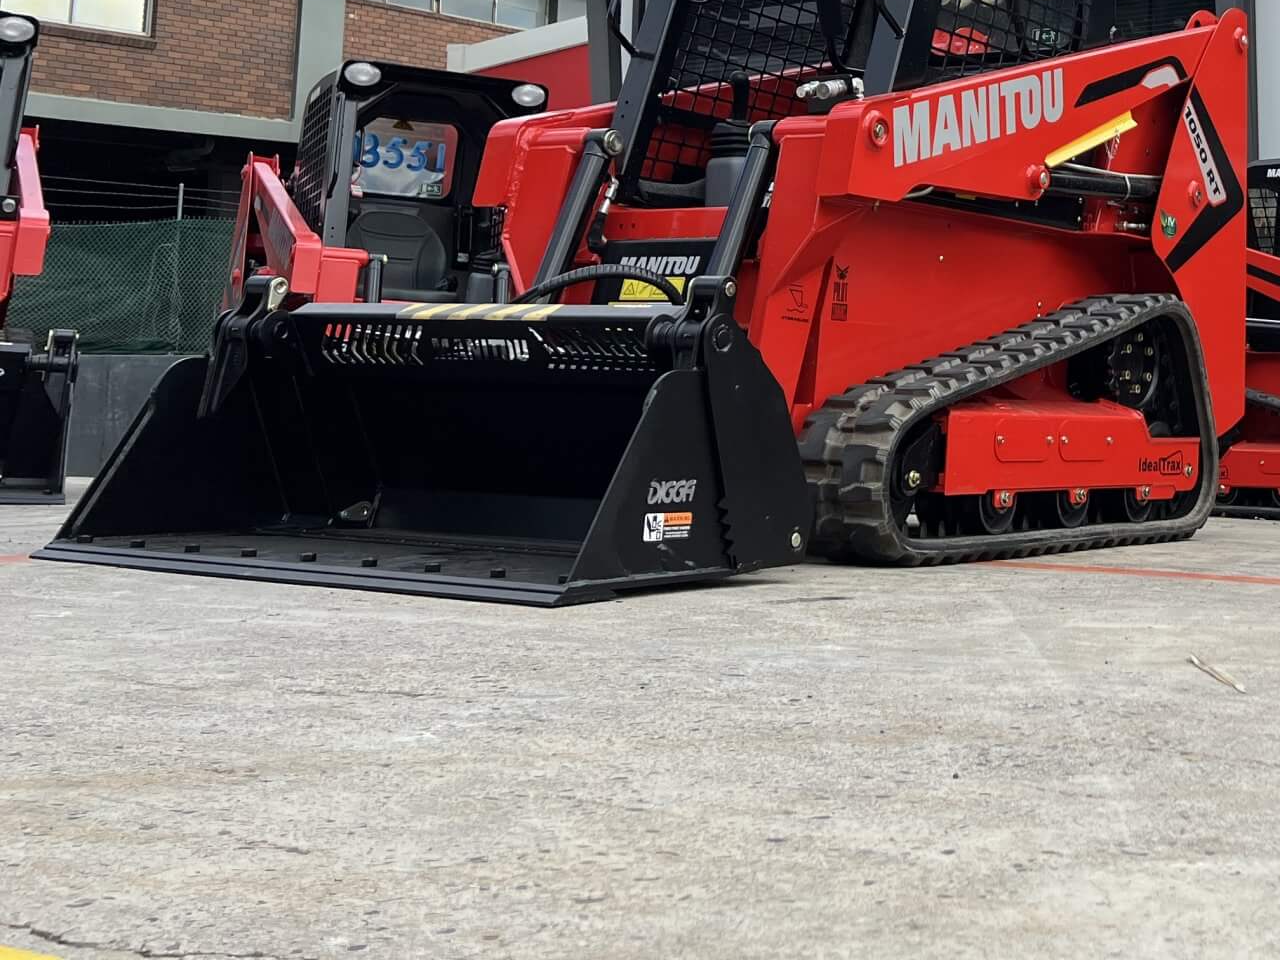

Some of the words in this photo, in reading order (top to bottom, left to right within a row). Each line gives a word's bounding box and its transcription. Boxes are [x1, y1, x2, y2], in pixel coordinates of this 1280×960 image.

[892, 67, 1064, 168] MANITOU
[1184, 106, 1208, 164] 1050
[1206, 168, 1221, 196] RT
[647, 479, 697, 505] DIGGA
